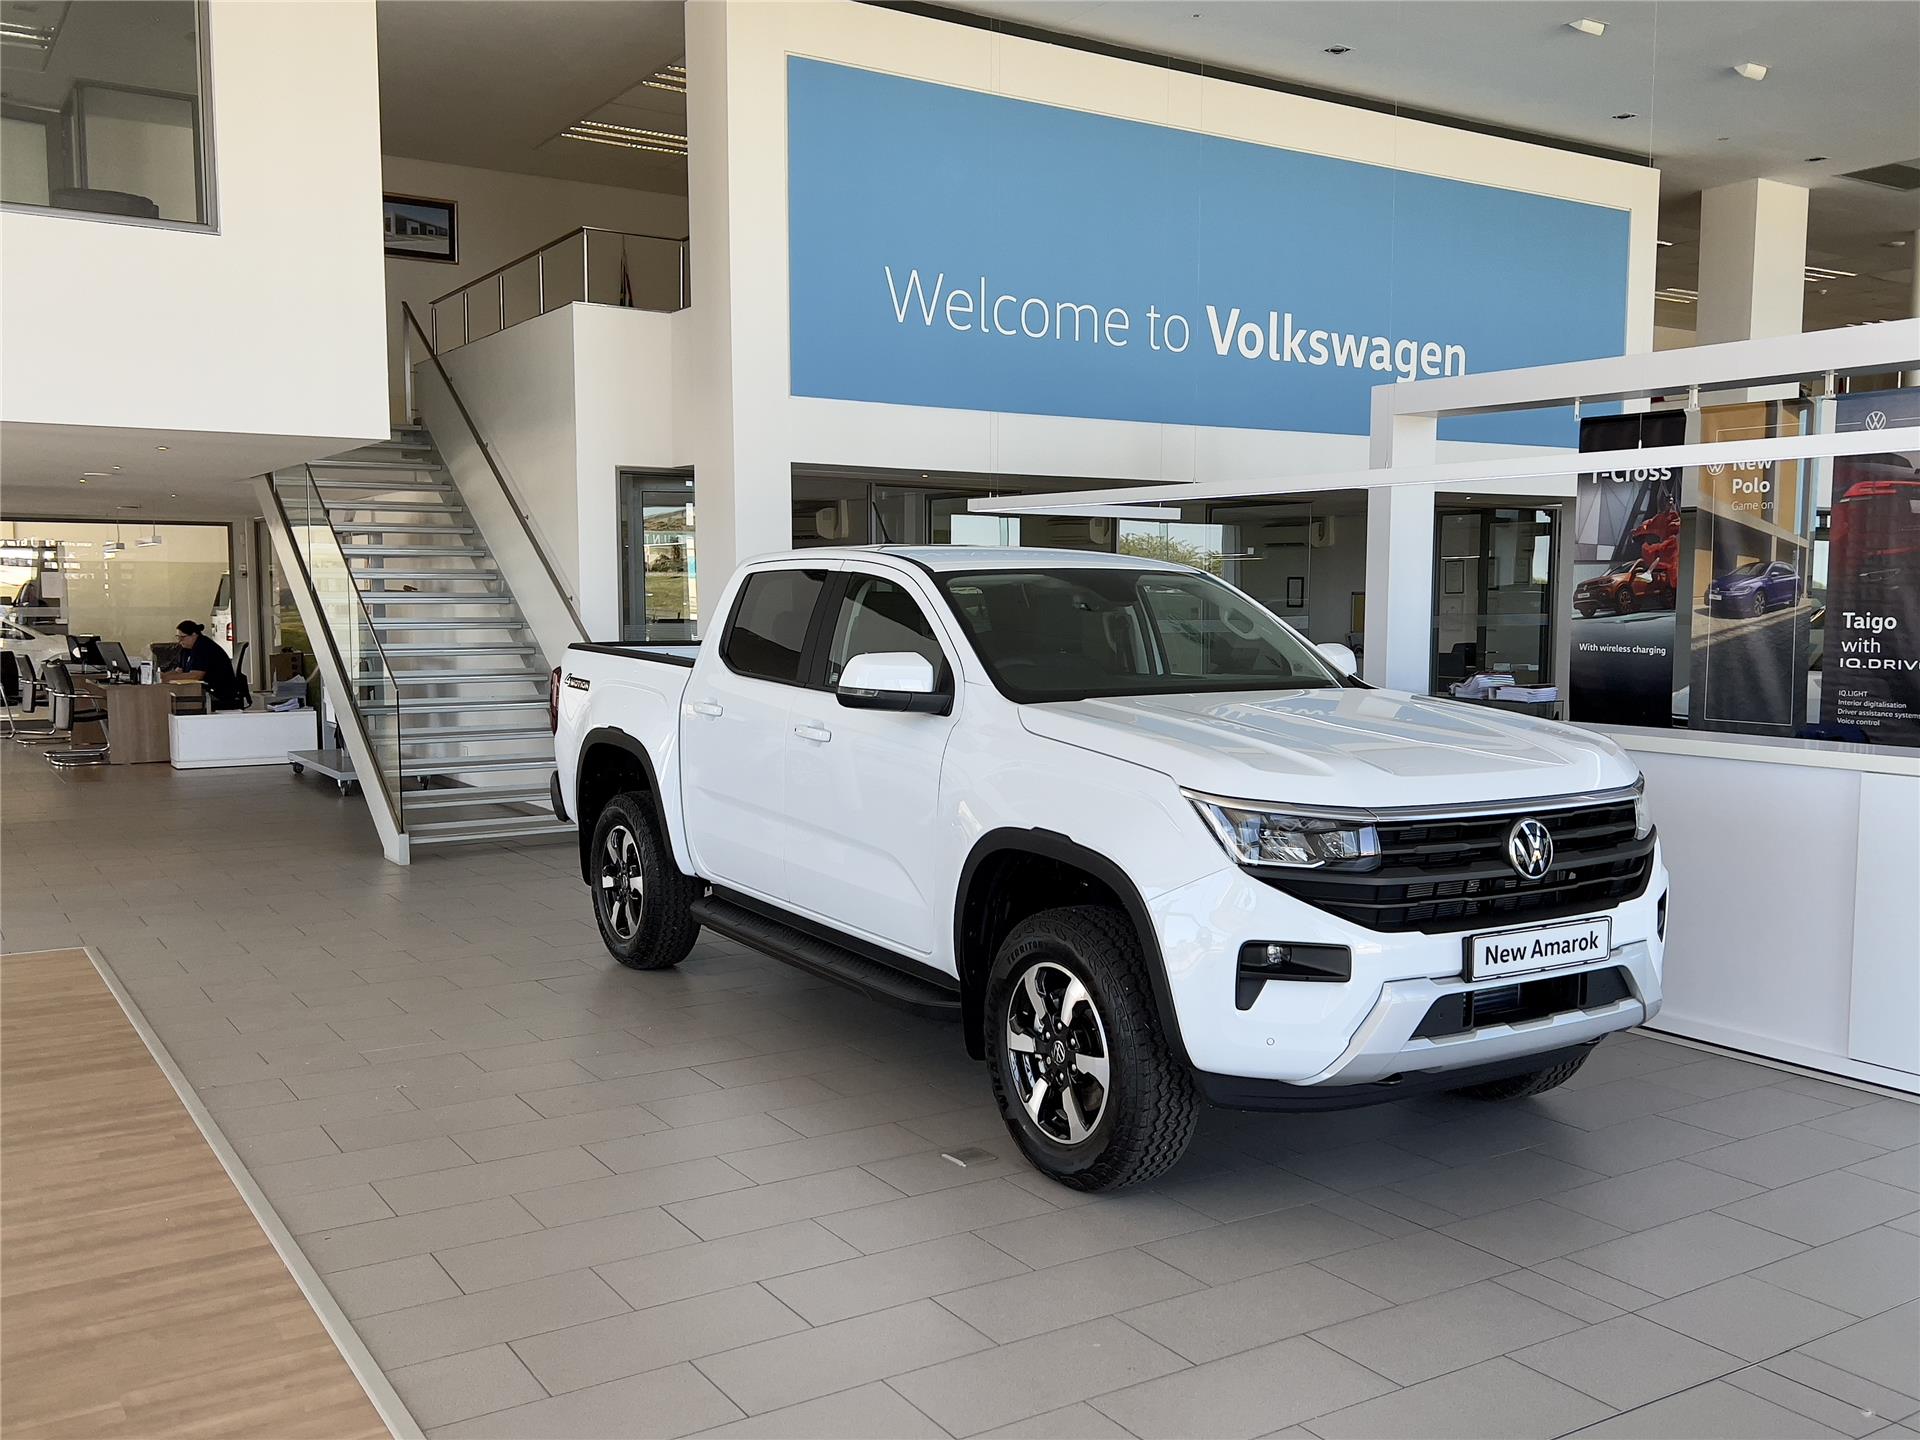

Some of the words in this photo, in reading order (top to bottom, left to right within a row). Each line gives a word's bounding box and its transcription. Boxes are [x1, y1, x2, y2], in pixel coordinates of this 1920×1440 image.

[884, 266, 1129, 347] Welcome
[1146, 304, 1190, 353] to
[1206, 305, 1466, 383] Volkswagen
[1732, 477, 1770, 494] Polo
[1731, 501, 1759, 511] Game
[1761, 502, 1774, 510] on
[1842, 612, 1897, 633] Taigo
[1579, 643, 1598, 652] With
[1600, 644, 1630, 653] wireless
[1632, 645, 1666, 656] charging
[1841, 637, 1881, 654] with
[1840, 658, 1920, 670] IQ.DRIV
[1838, 699, 1862, 707] Interior
[1863, 700, 1907, 709] digitalisation
[1837, 708, 1857, 716] Driver
[1858, 710, 1894, 718] assistance
[1837, 717, 1855, 725] Voice
[1855, 718, 1880, 726] control
[1485, 945, 1527, 965] New
[1530, 930, 1599, 959] Amarok
